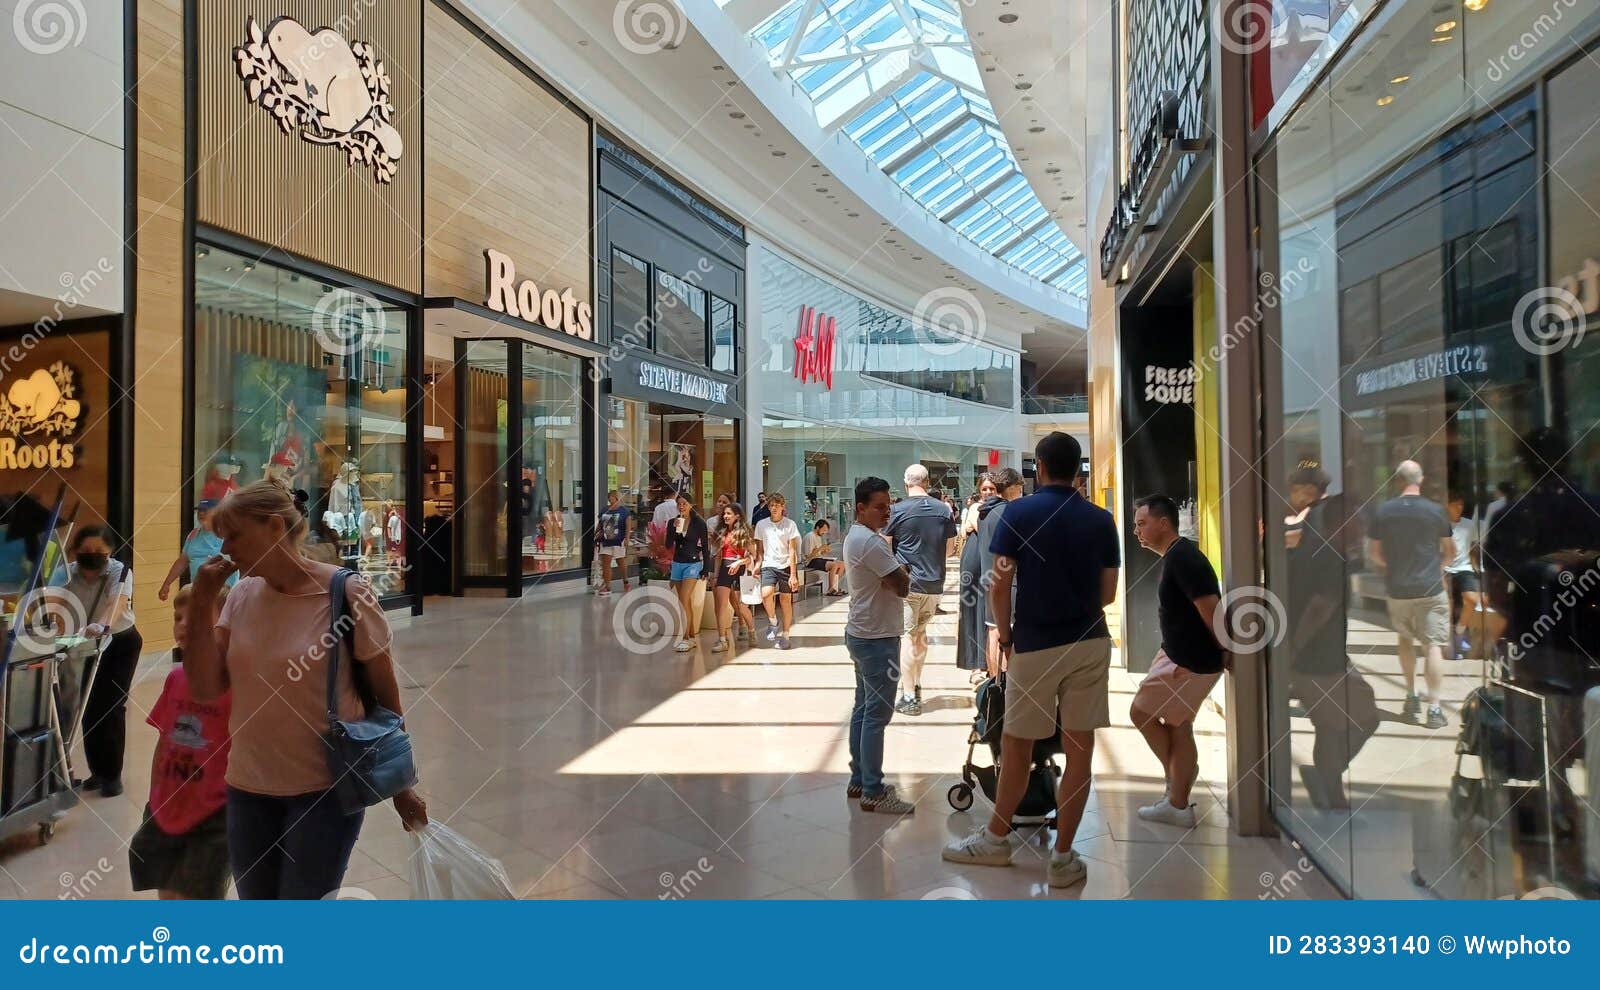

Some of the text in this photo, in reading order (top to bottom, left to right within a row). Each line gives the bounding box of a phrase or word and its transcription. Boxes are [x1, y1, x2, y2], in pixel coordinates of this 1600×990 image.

[484, 248, 592, 340] Roots
[794, 303, 835, 391] H&M
[640, 361, 728, 404] STEVE MADDEN
[0, 437, 74, 469] Roots
